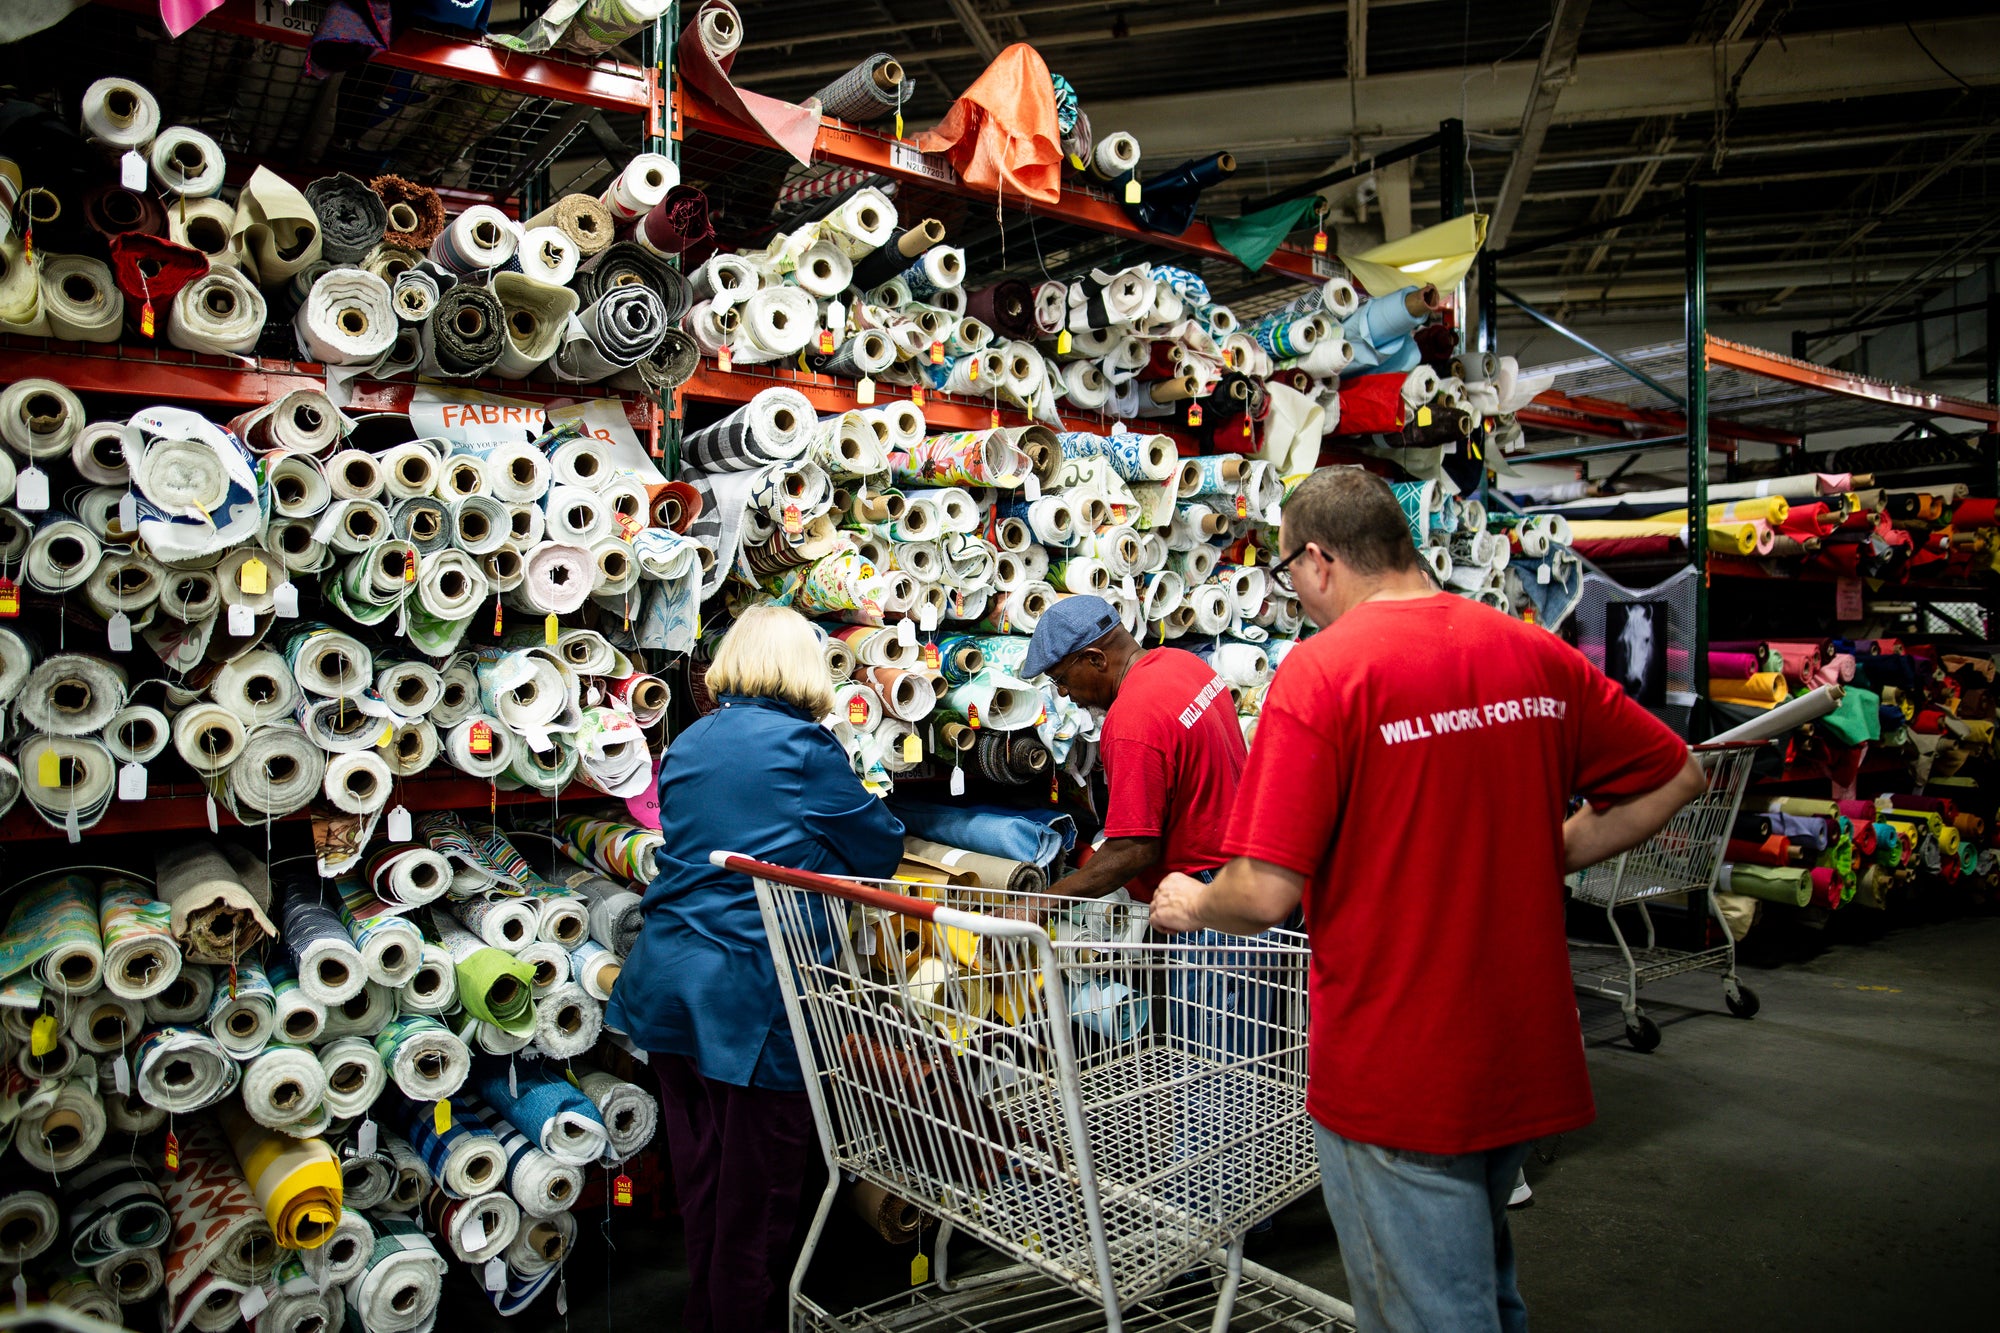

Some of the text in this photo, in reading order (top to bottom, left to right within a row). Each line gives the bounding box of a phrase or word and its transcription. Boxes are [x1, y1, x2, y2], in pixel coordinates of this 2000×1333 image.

[906, 161, 945, 180] N2L07203
[473, 727, 490, 735] SALE
[1379, 716, 1432, 745] WILL
[1430, 707, 1484, 734] WORK
[1483, 700, 1523, 726] FOR
